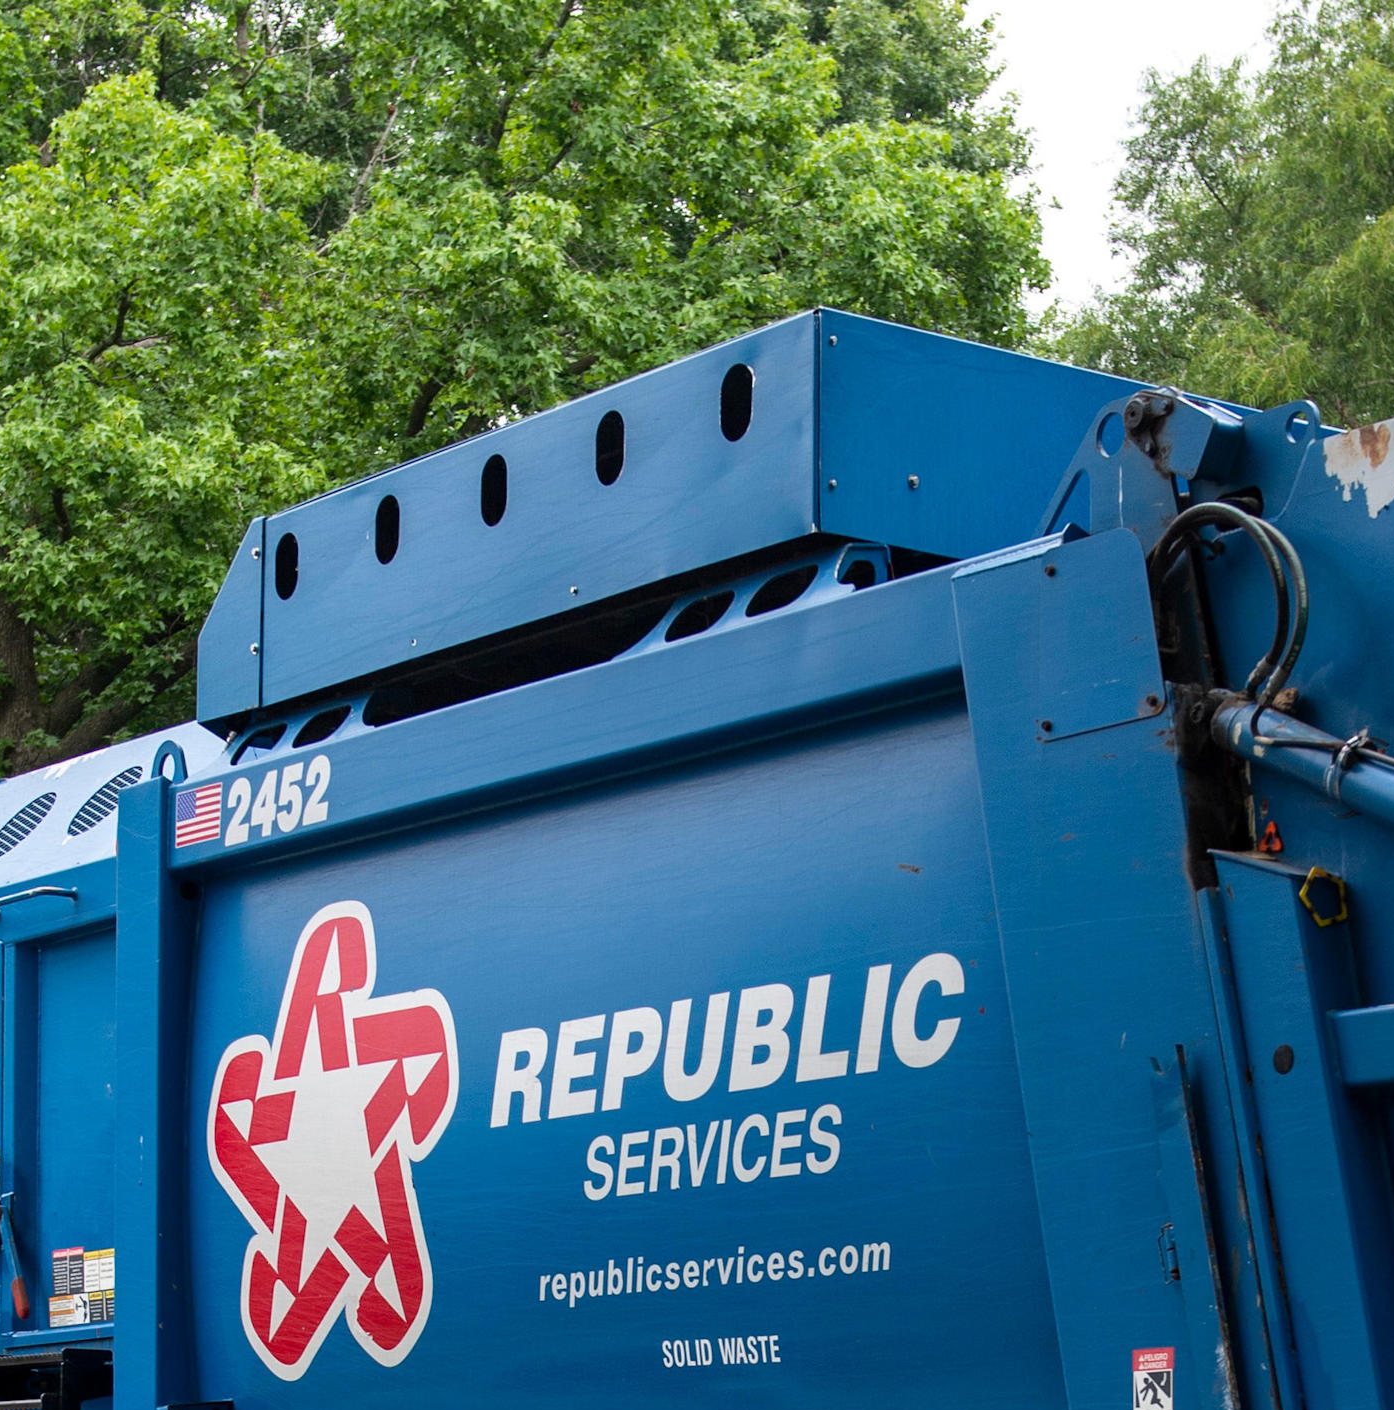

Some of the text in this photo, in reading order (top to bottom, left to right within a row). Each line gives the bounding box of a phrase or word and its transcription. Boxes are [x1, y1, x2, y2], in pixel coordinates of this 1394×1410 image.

[224, 754, 332, 847] 2452
[490, 953, 966, 1128] REPUBLIC
[583, 1104, 842, 1201] SERVICES
[539, 1242, 891, 1308] republicservices.com
[662, 1335, 781, 1368] SOLID WASTE
